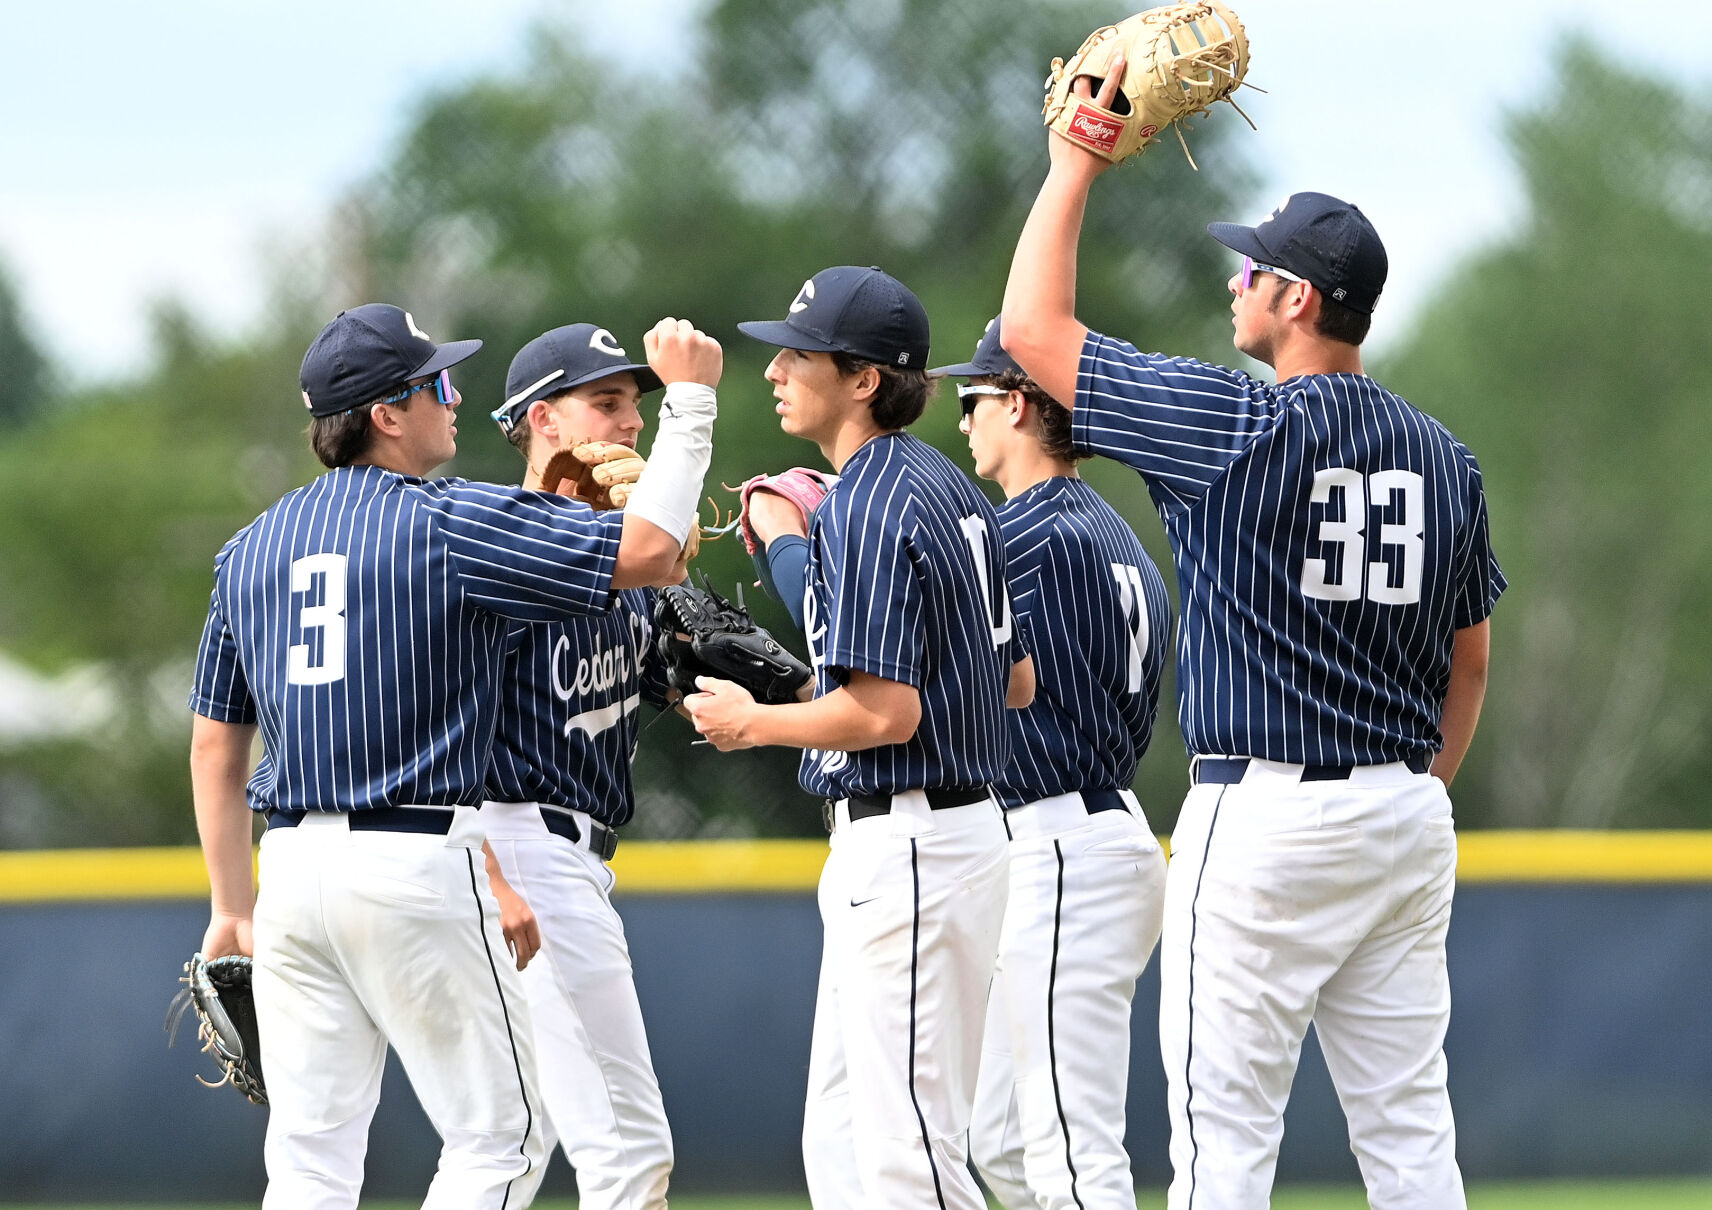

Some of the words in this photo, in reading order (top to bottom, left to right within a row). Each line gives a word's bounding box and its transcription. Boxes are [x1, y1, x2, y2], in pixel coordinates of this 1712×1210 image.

[1074, 116, 1116, 139] Rawlings
[789, 279, 815, 313] C
[589, 328, 626, 357] C
[1301, 467, 1423, 605] 33
[288, 553, 347, 685] 3
[552, 630, 630, 701] Cedar
